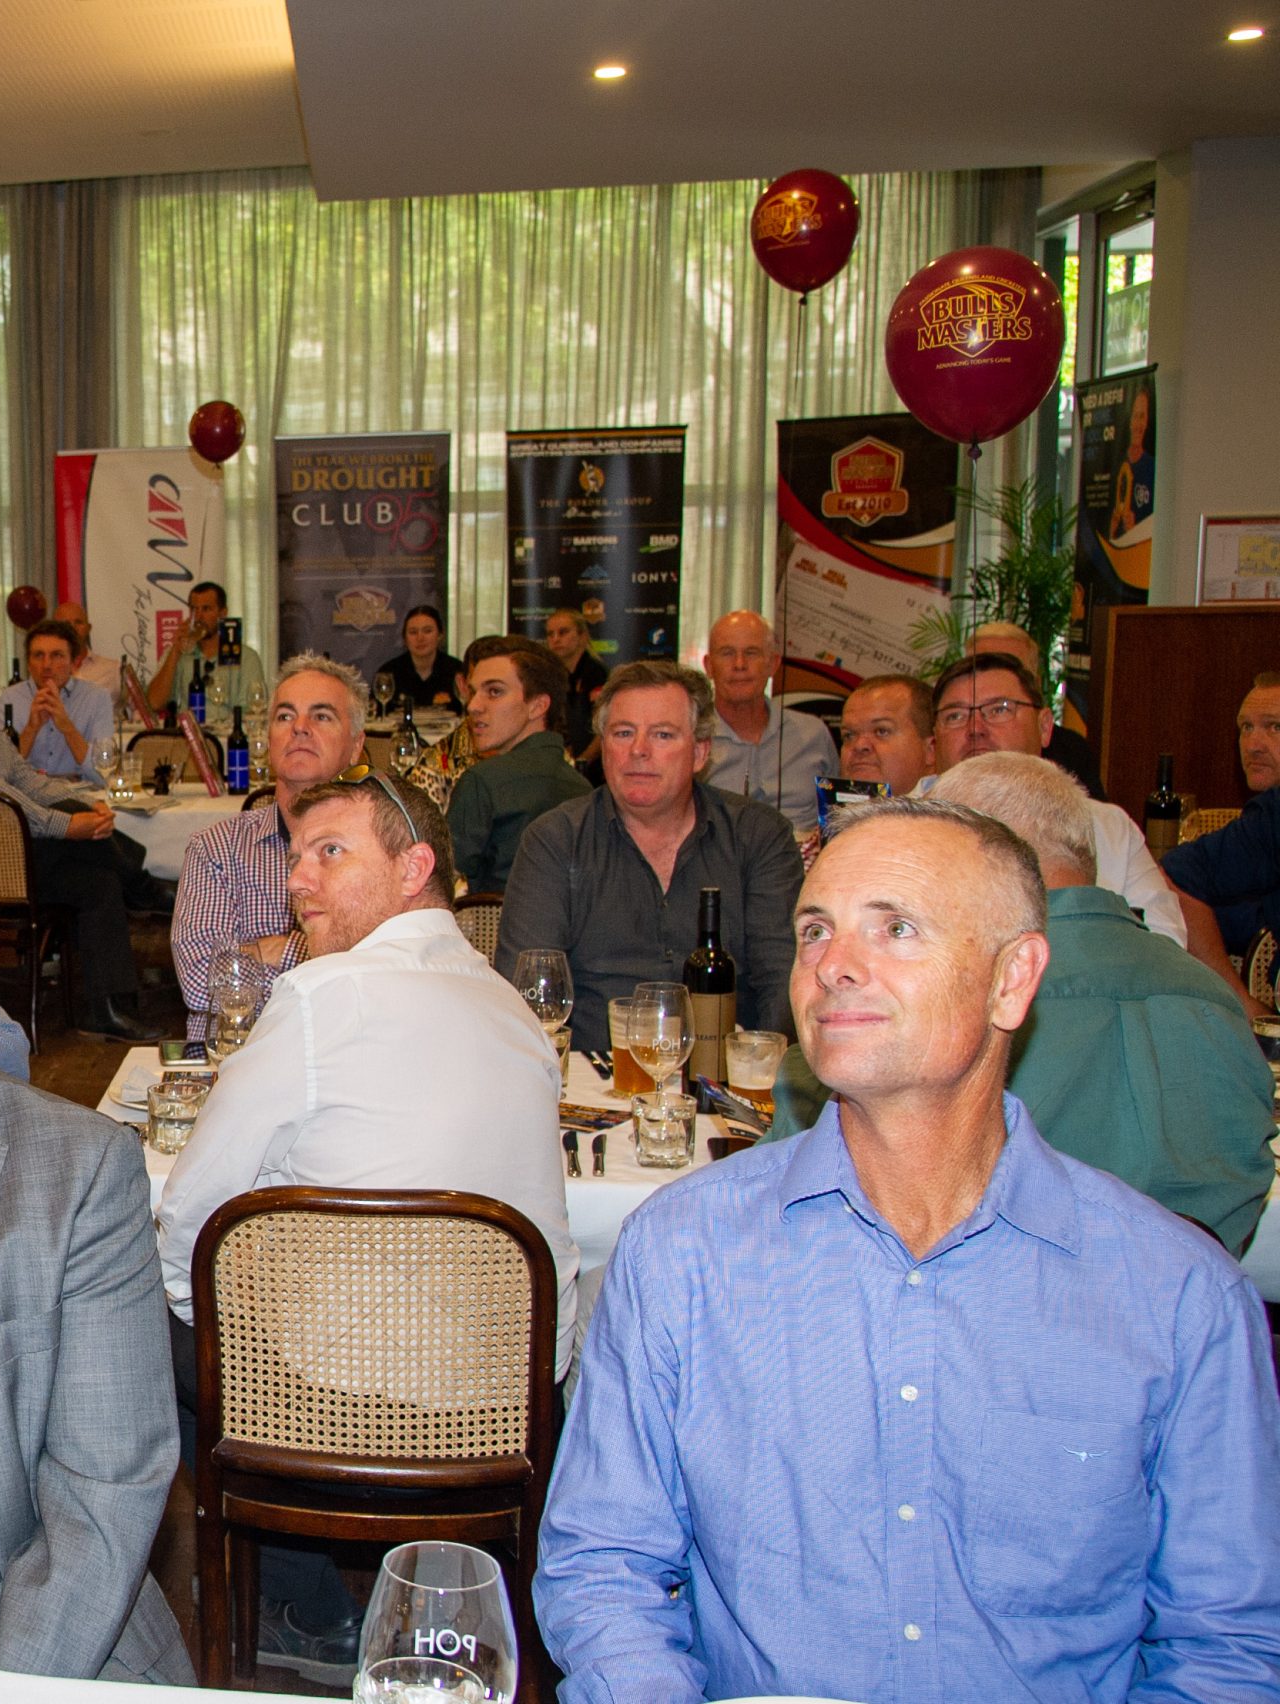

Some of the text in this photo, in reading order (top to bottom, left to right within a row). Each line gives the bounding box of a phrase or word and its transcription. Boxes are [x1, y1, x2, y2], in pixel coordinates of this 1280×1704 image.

[932, 292, 1016, 324] BULLS
[917, 316, 1033, 351] MASTERS
[935, 359, 970, 369] ADVANCING
[1103, 425, 1115, 441] OR
[290, 464, 435, 492] DROUGHT
[292, 501, 394, 527] CLUB
[652, 1038, 681, 1051] POH
